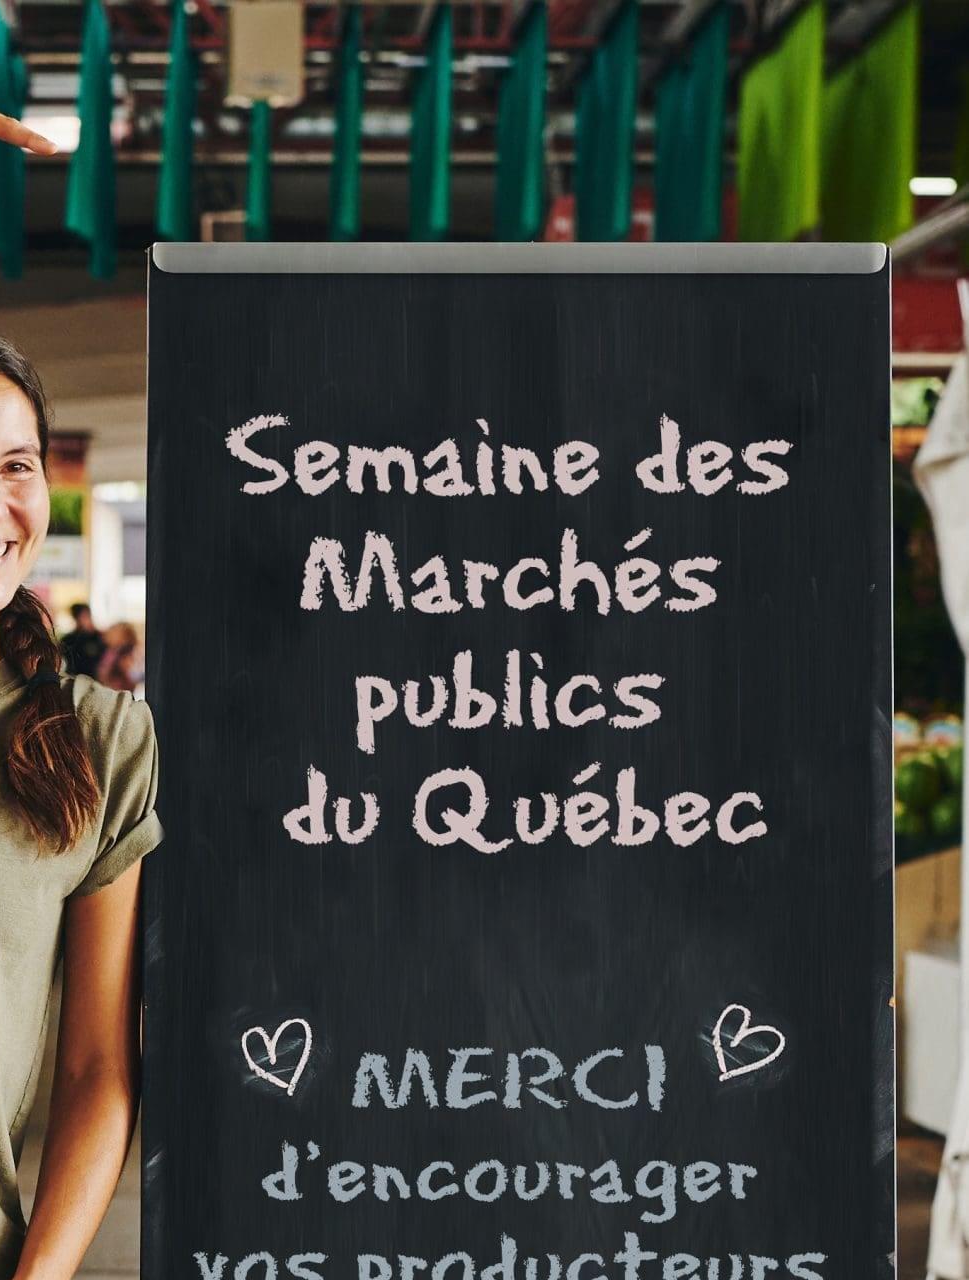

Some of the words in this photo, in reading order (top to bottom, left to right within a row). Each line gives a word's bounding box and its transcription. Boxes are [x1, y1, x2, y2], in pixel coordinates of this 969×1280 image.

[225, 413, 599, 496] Semaine
[636, 413, 793, 496] des
[300, 527, 721, 616] Marchés
[356, 649, 665, 754] publics
[283, 764, 380, 844] du
[412, 762, 767, 853] Québec
[352, 1044, 666, 1111] MERCI
[262, 1141, 757, 1223] d'encourager
